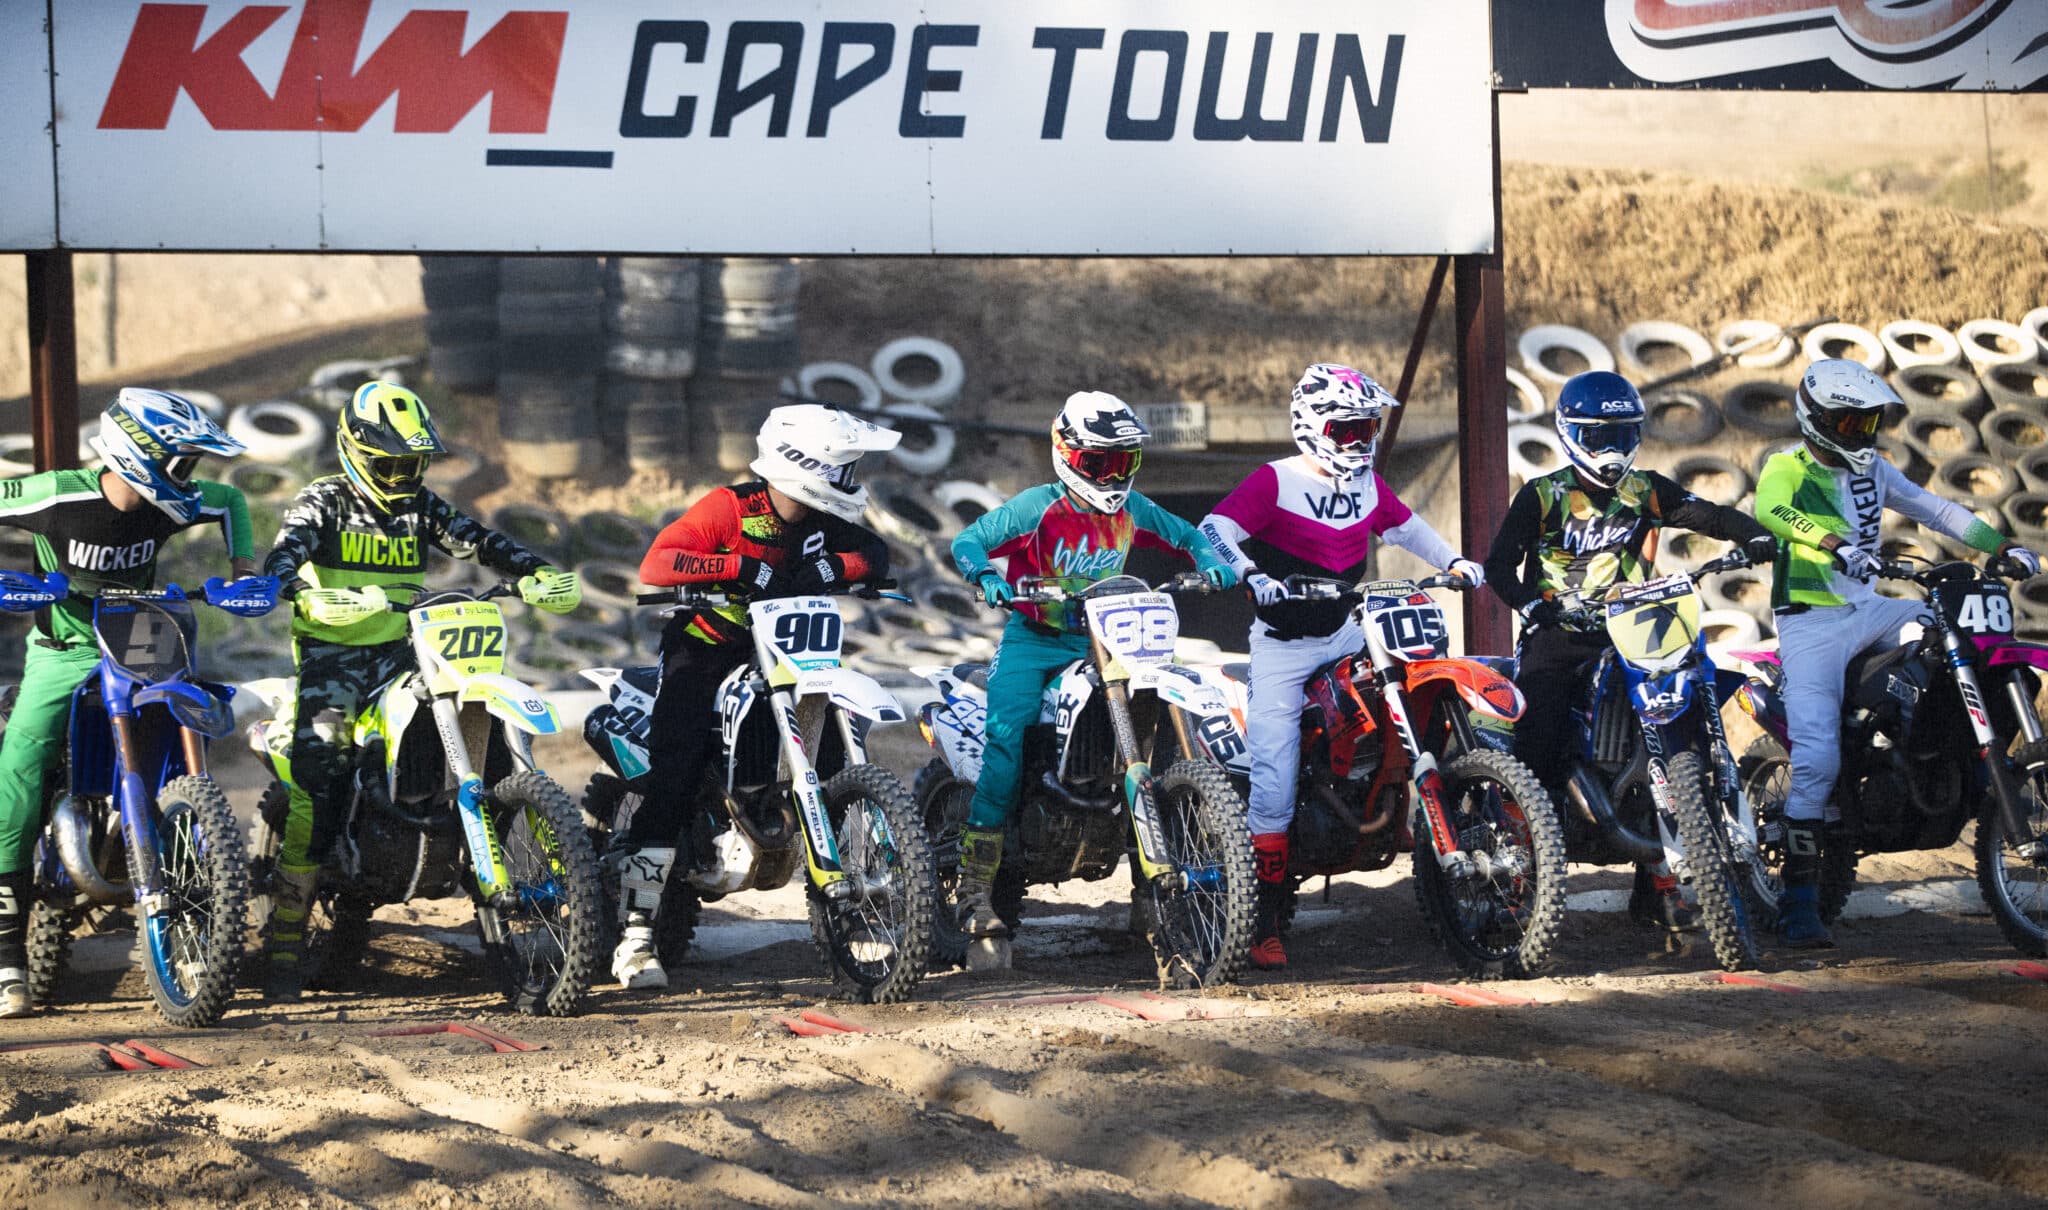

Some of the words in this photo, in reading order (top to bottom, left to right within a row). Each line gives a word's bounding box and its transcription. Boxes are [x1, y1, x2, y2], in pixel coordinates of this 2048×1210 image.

[97, 0, 569, 134] KTM
[619, 20, 981, 139] CAPE
[1031, 26, 1407, 144] TOWN
[1600, 400, 1635, 410] ACE
[113, 410, 168, 460] 100%
[775, 441, 837, 480] 100%
[1770, 504, 1815, 534] WICKED
[1849, 477, 1882, 553] ICKED
[67, 539, 156, 572] WICKED
[673, 552, 725, 575] WICKED
[1053, 534, 1128, 578] Wicked
[1202, 522, 1222, 546] WICKED
[1214, 542, 1239, 565] FAMILY
[1669, 583, 1689, 594] ACE
[774, 612, 841, 655] 90
[1375, 608, 1446, 651] 105
[1633, 602, 1679, 655] 7
[1957, 594, 2012, 632] 48
[124, 612, 178, 666] 9
[438, 625, 504, 661] 202
[806, 791, 823, 841] METZELER
[1144, 793, 1167, 857] UNLOP
